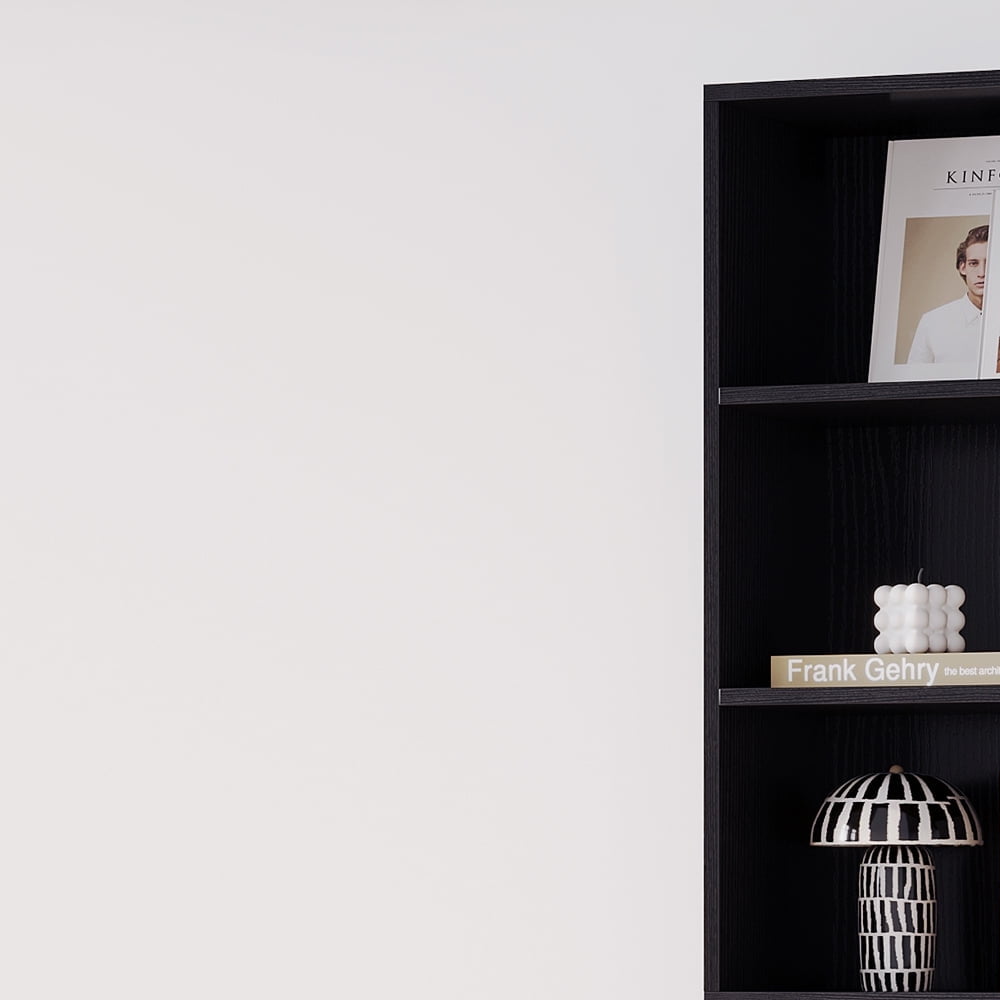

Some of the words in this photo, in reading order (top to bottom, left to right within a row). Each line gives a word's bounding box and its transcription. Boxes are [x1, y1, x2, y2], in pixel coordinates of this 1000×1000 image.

[787, 658, 857, 682] Frank
[864, 657, 940, 687] Gehry
[944, 667, 958, 676] the
[959, 666, 978, 676] best
